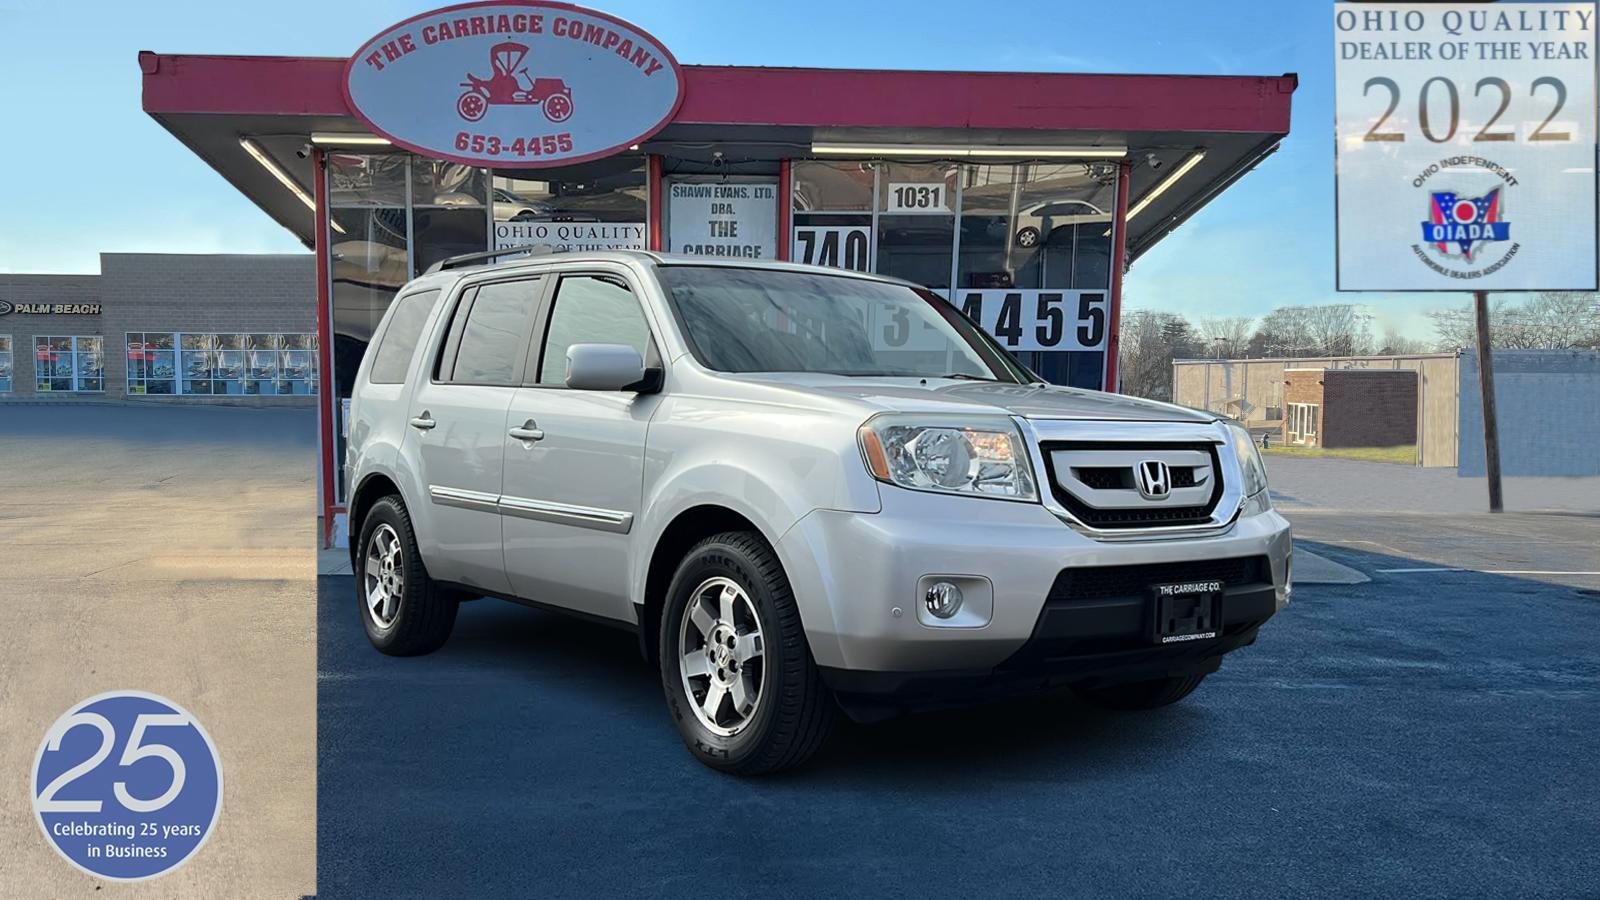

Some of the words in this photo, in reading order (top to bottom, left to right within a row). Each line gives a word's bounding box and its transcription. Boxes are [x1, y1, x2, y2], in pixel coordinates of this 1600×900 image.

[1337, 10, 1425, 32] OHIO
[1442, 10, 1593, 36] QUALITY
[366, 33, 416, 71] THE
[423, 14, 543, 46] CARRIAGE
[553, 16, 664, 77] COMPANY
[1340, 41, 1433, 60] DEALER
[1438, 41, 1470, 60] OF
[1474, 41, 1522, 60] THE
[1528, 41, 1589, 60] YEAR
[1362, 75, 1571, 144] 2022
[455, 131, 573, 156] 653-4455
[1412, 163, 1439, 189] OHIO
[1440, 155, 1519, 187] INDEPENDENT
[673, 185, 711, 198] SHAWN
[754, 187, 775, 199] LTD.
[894, 186, 940, 208] 1031
[711, 203, 736, 215] DBA.
[497, 226, 548, 239] OHIO
[557, 226, 644, 241] QUALITY
[708, 220, 738, 238] THE
[1432, 225, 1495, 241] OIADA
[798, 230, 868, 272] 740
[1449, 269, 1482, 280] DEALERS
[15, 303, 50, 314] PALM
[54, 304, 101, 314] BEACH
[1160, 585, 1173, 595] THE
[1174, 583, 1208, 594] CARRIAGE
[1208, 582, 1221, 592] CO.
